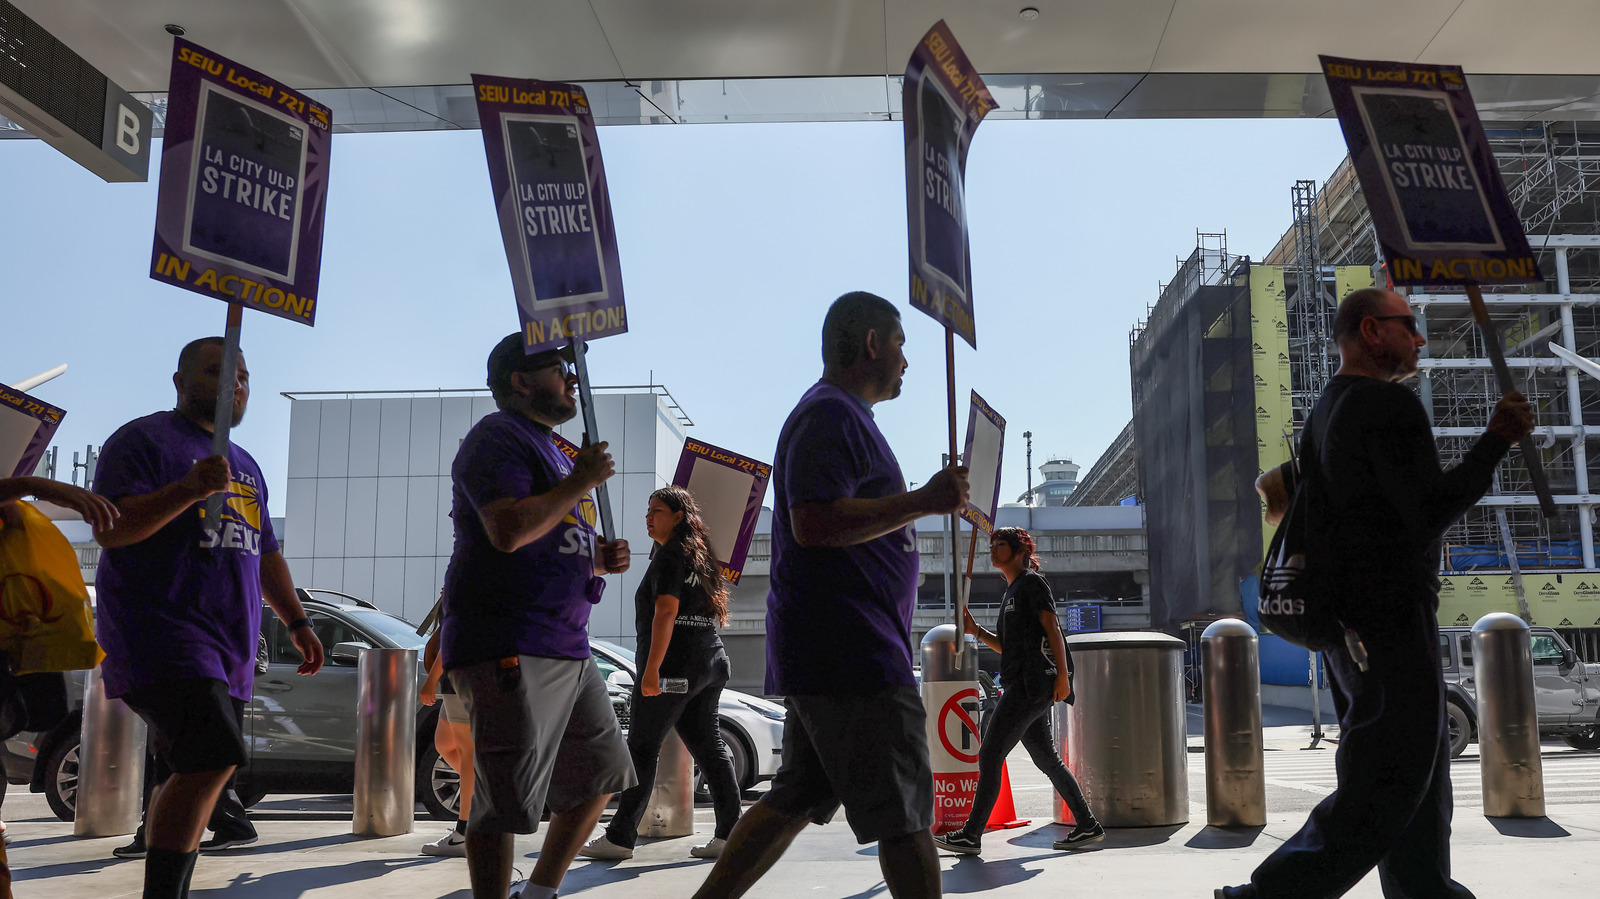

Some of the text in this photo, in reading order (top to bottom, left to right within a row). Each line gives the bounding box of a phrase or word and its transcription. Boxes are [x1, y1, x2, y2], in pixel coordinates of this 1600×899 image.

[177, 47, 305, 114] SEIU Local 721
[942, 55, 967, 88] Local
[1327, 63, 1436, 84] SEIU Local 721
[479, 84, 569, 107] SEIU Local 721
[116, 103, 140, 155] B
[926, 142, 935, 166] LA
[1383, 144, 1461, 161] LA CITY ULP
[205, 145, 295, 192] LA CITY ULP
[1391, 162, 1473, 190] STRIKE
[202, 166, 292, 221] STRIKE
[521, 183, 585, 201] LA CITY ULP
[525, 204, 591, 236] STRIKE
[1393, 258, 1536, 280] IN ACTION!
[155, 253, 315, 318] IN ACTION!
[912, 274, 927, 305] IN
[526, 305, 625, 346] IN ACTION!
[24, 401, 45, 414] 721
[561, 444, 578, 458] 721
[686, 442, 710, 455] SEIU
[710, 450, 736, 464] Local
[738, 459, 755, 470] 721
[966, 508, 993, 535] ACTION!
[935, 779, 978, 792] No Wa
